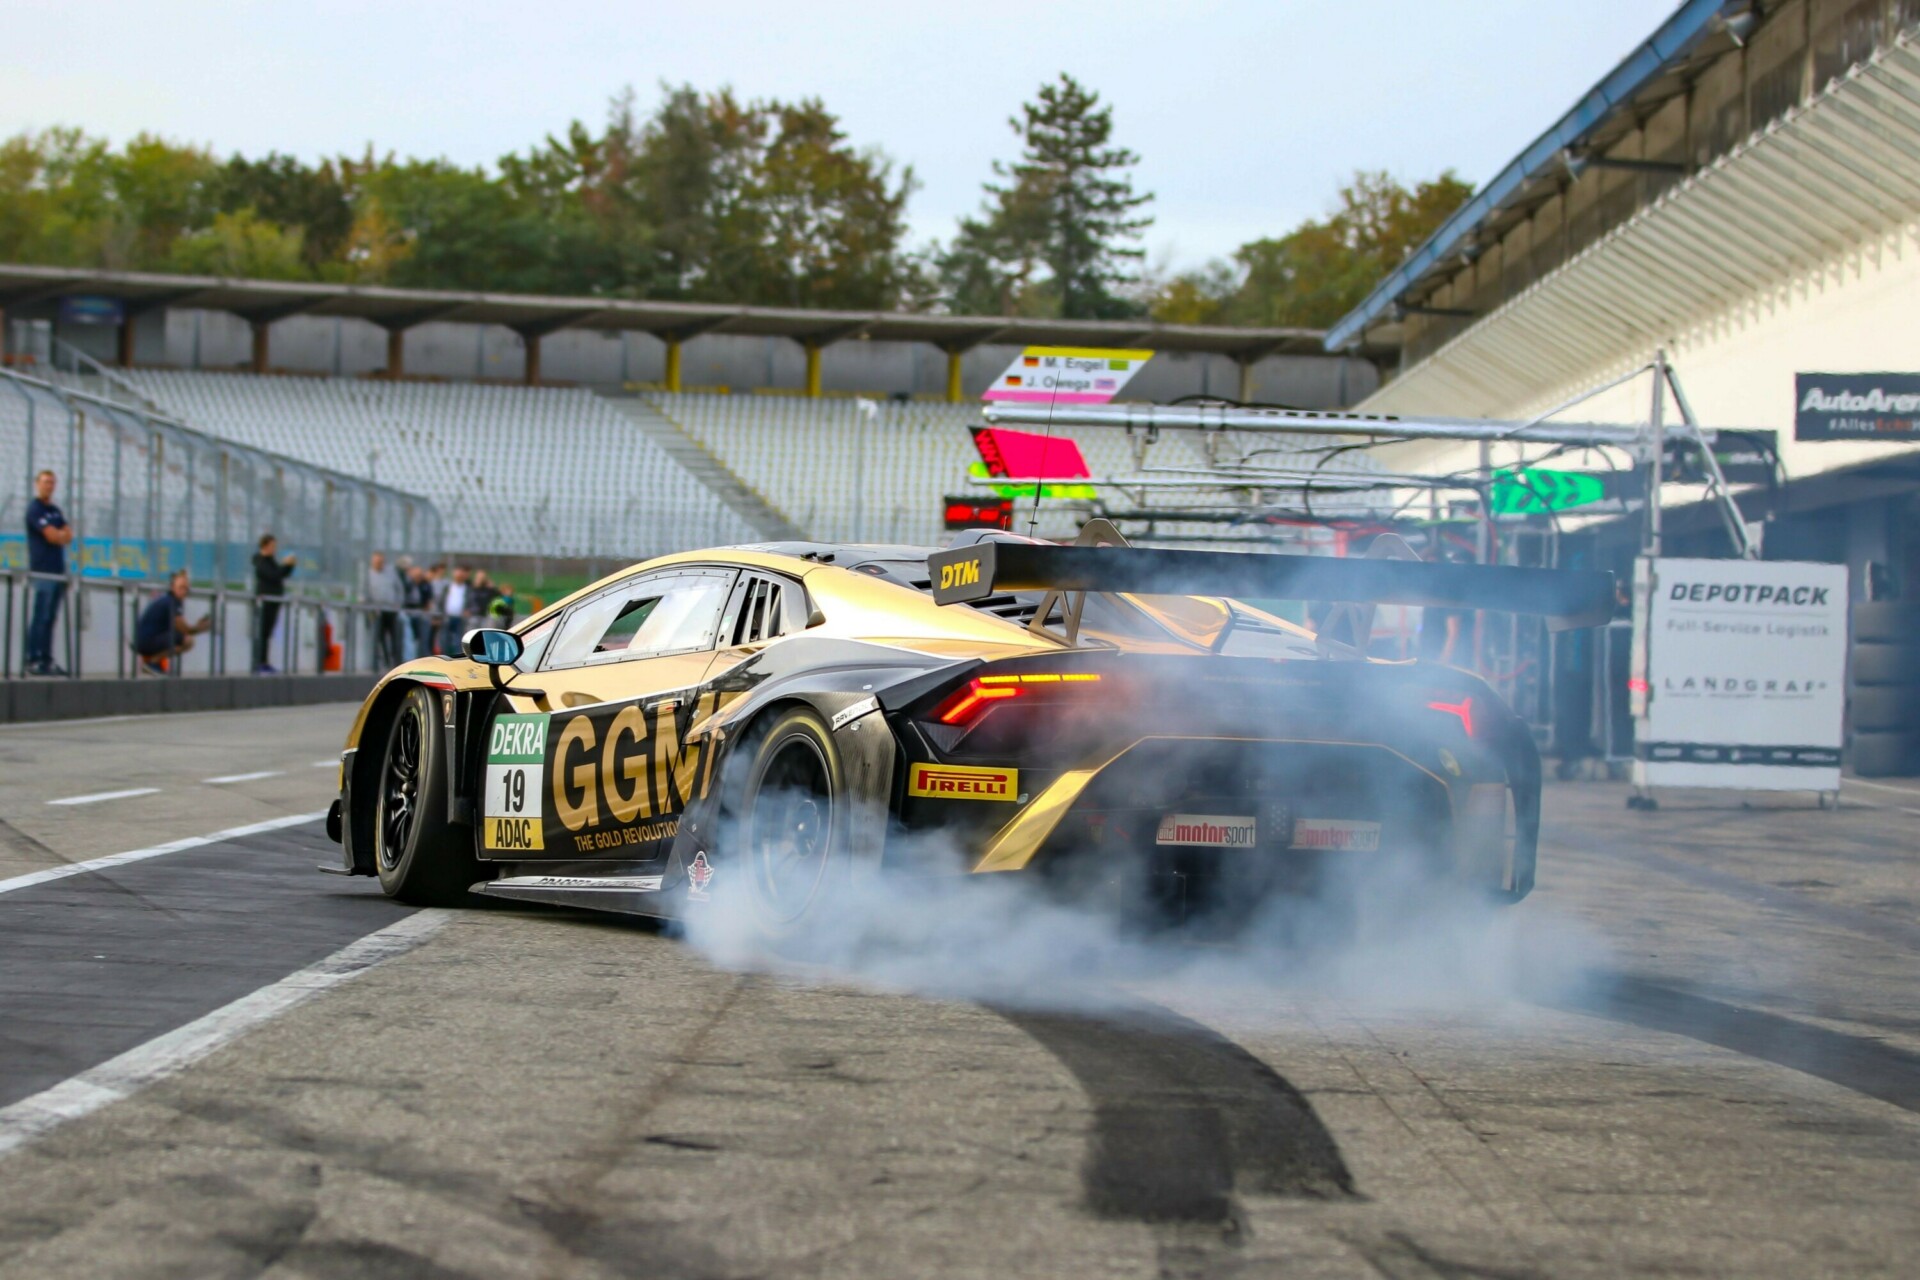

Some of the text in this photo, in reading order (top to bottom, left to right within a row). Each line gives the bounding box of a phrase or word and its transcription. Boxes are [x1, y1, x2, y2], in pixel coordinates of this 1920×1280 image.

[1065, 358, 1104, 373] Engel
[1043, 376, 1091, 391] Owega
[940, 559, 980, 590] DTM
[1670, 583, 1830, 606] DEPOTPACK
[1767, 623, 1830, 639] Logistik
[1665, 677, 1816, 693] LANDGRAF
[490, 722, 544, 756] DEKRA
[503, 769, 526, 813] 19
[918, 770, 1008, 795] PIRELLI
[495, 819, 532, 849] ADAC
[574, 834, 595, 852] THE
[595, 830, 622, 849] GOLD
